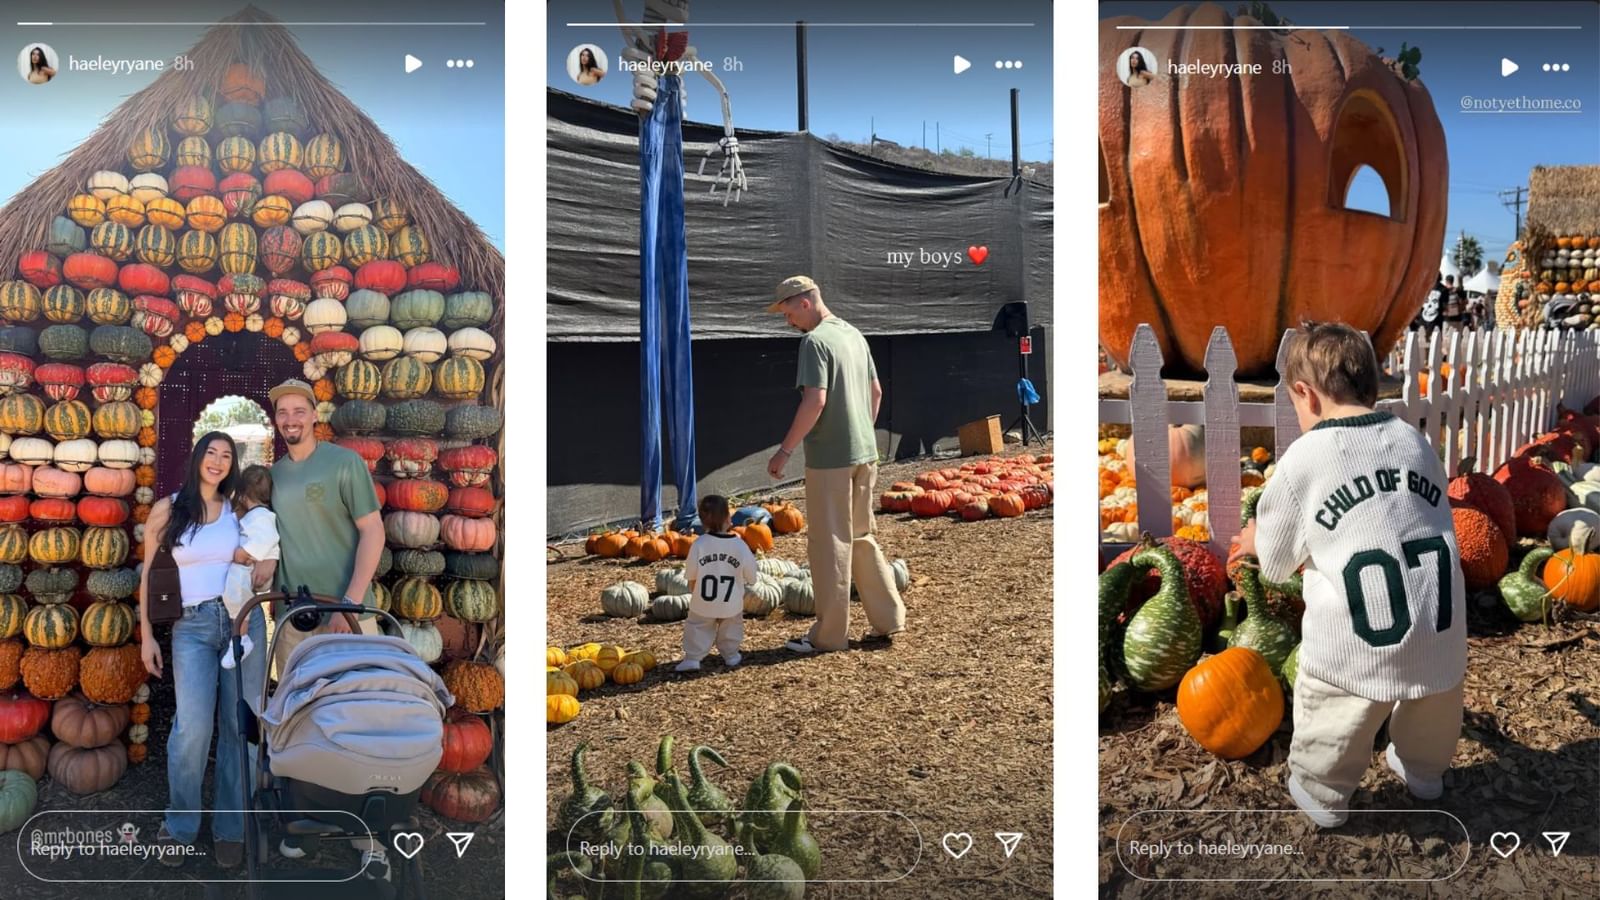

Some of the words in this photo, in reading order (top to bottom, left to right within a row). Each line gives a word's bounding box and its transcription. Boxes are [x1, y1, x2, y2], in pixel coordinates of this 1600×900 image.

[1315, 475, 1375, 531] CHILD
[1375, 469, 1401, 493] OF
[1407, 470, 1442, 508] GOD
[699, 553, 718, 566] CHILD
[719, 553, 728, 561] OF
[727, 556, 741, 568] GOD
[701, 574, 735, 602] 07
[1342, 535, 1453, 648] 07
